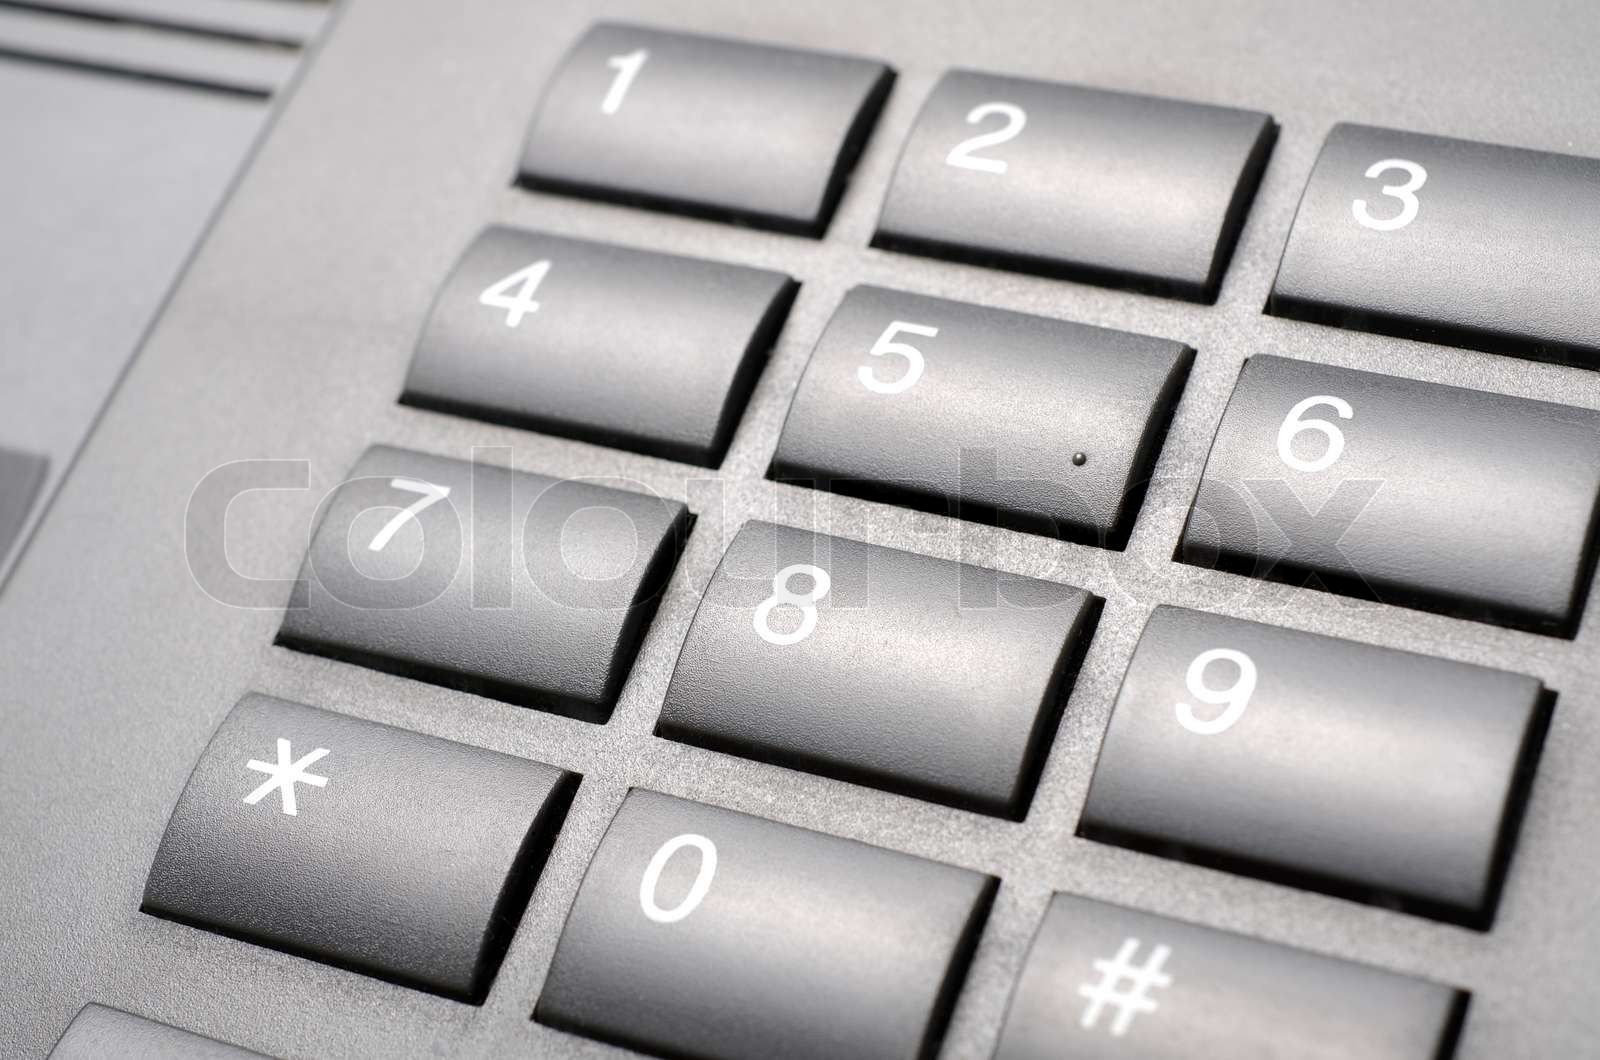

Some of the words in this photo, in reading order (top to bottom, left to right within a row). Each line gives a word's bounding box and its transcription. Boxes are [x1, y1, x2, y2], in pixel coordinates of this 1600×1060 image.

[601, 50, 648, 112] 1
[945, 103, 1027, 174] 2
[1351, 158, 1427, 230] 3
[480, 260, 553, 328] 4
[856, 321, 938, 395] 5
[1276, 395, 1353, 472] 6
[367, 479, 449, 551] 7
[753, 564, 832, 646] 8
[1175, 648, 1258, 735] 9
[640, 833, 718, 924] 0
